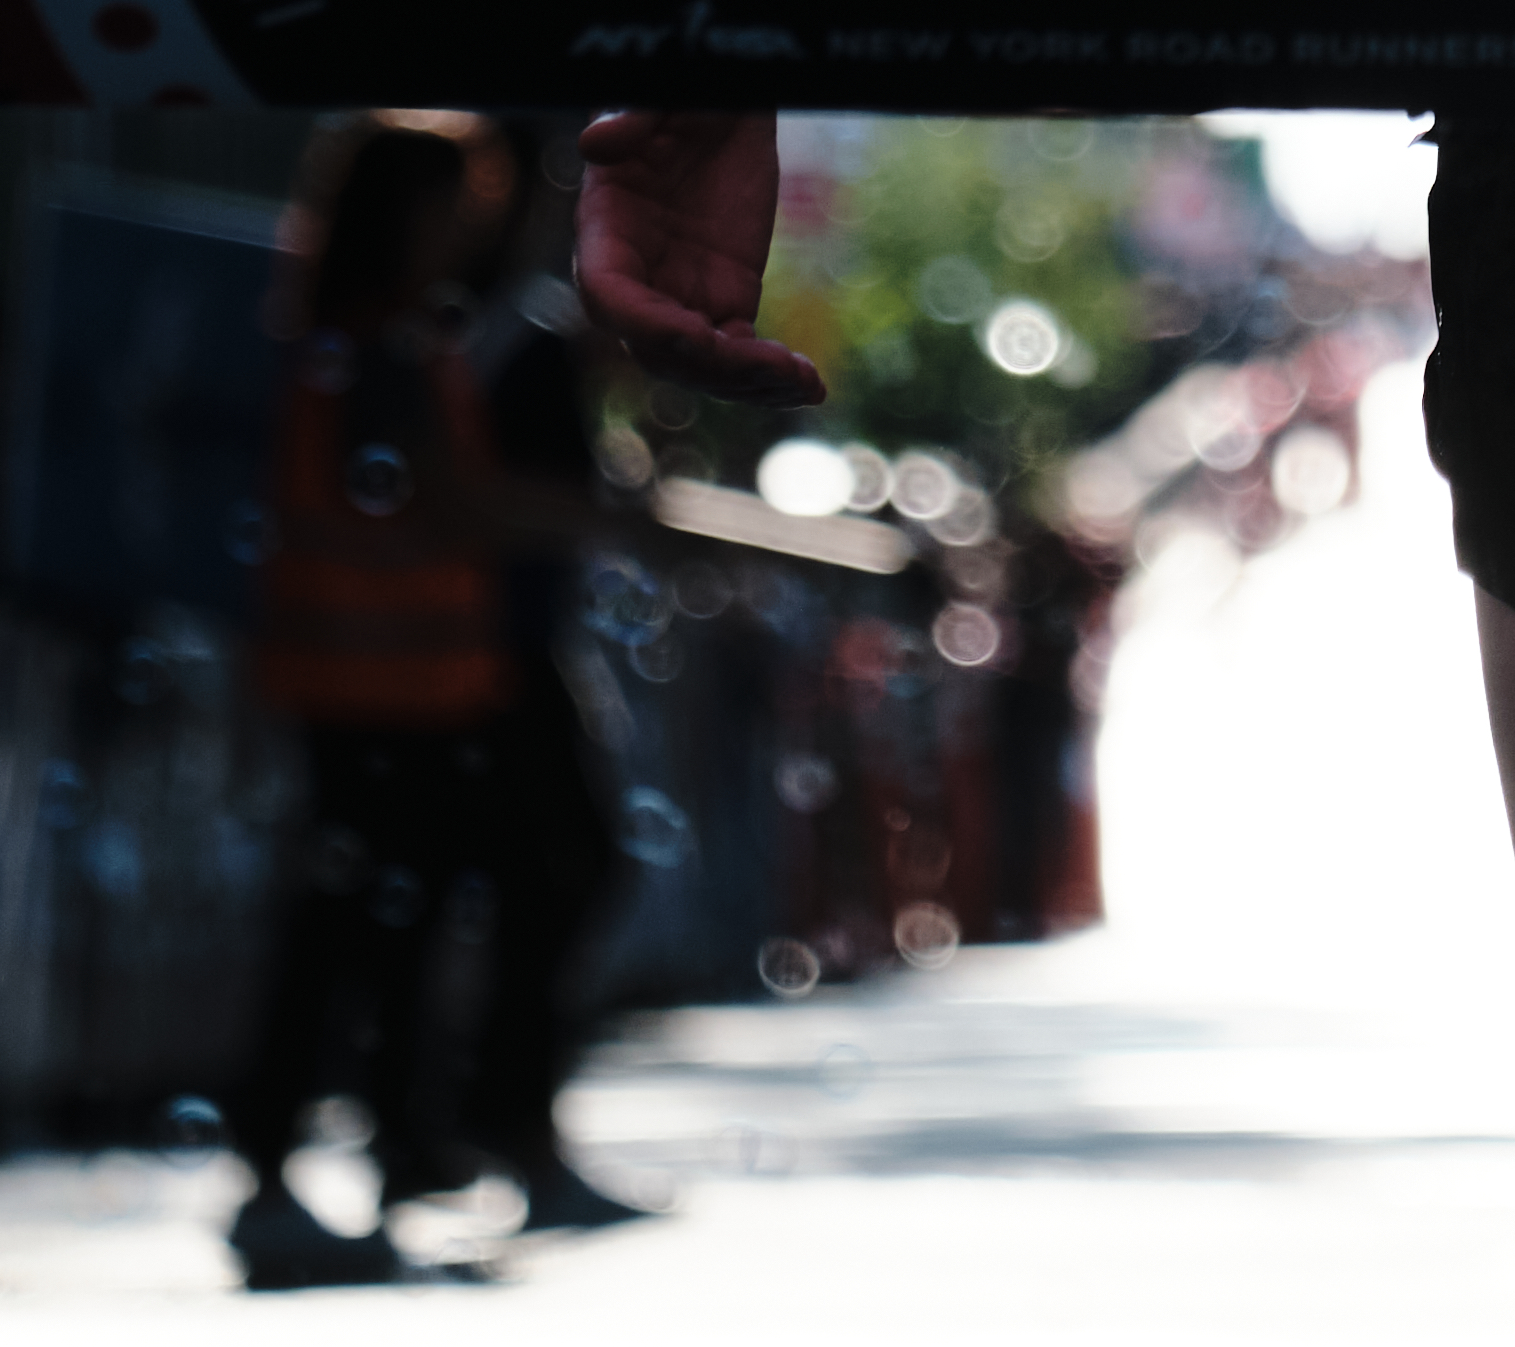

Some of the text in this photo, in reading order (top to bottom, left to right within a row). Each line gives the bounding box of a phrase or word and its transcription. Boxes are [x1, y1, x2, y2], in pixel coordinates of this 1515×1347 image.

[826, 28, 953, 61] NEW
[966, 29, 1109, 64] YORK
[1125, 30, 1276, 65] ROAD
